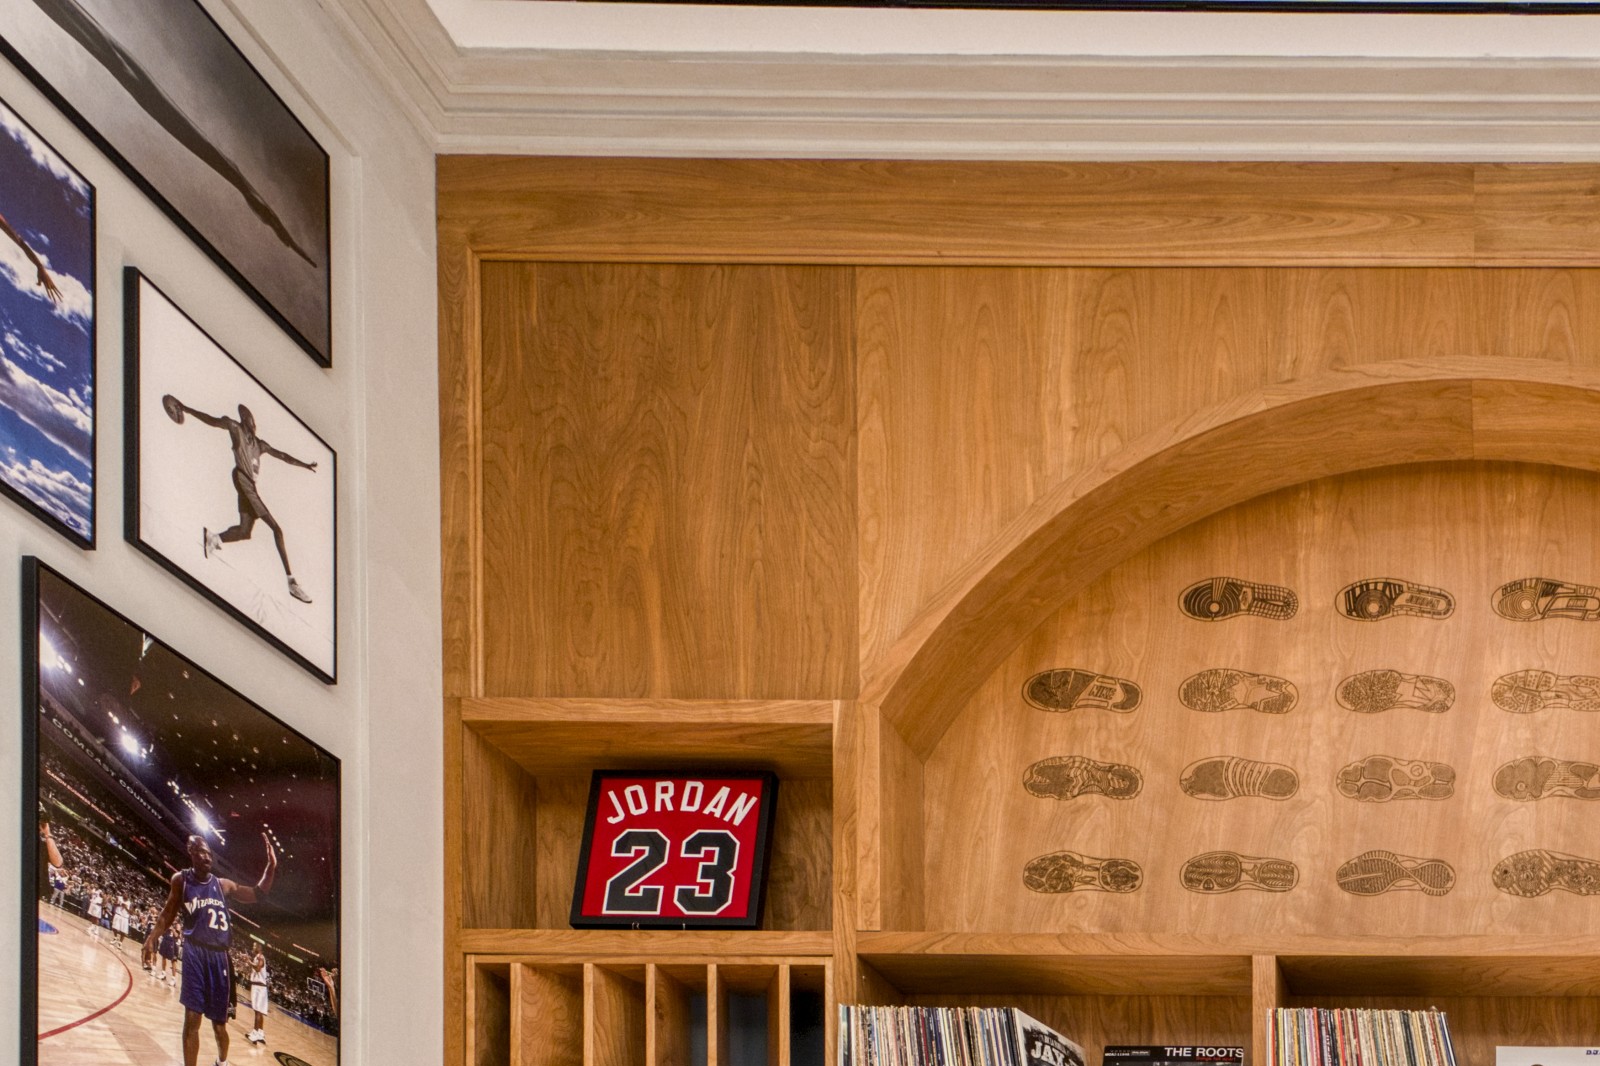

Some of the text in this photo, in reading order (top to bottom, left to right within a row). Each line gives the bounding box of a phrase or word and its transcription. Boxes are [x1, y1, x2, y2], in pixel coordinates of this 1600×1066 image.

[52, 717, 116, 777] COMCAST
[118, 778, 163, 820] COUNTRY
[606, 780, 758, 826] JORDAN
[602, 828, 740, 916] 23
[184, 896, 225, 915] WIZARDS
[207, 908, 229, 931] 23
[1164, 1047, 1244, 1058] THE ROOTS
